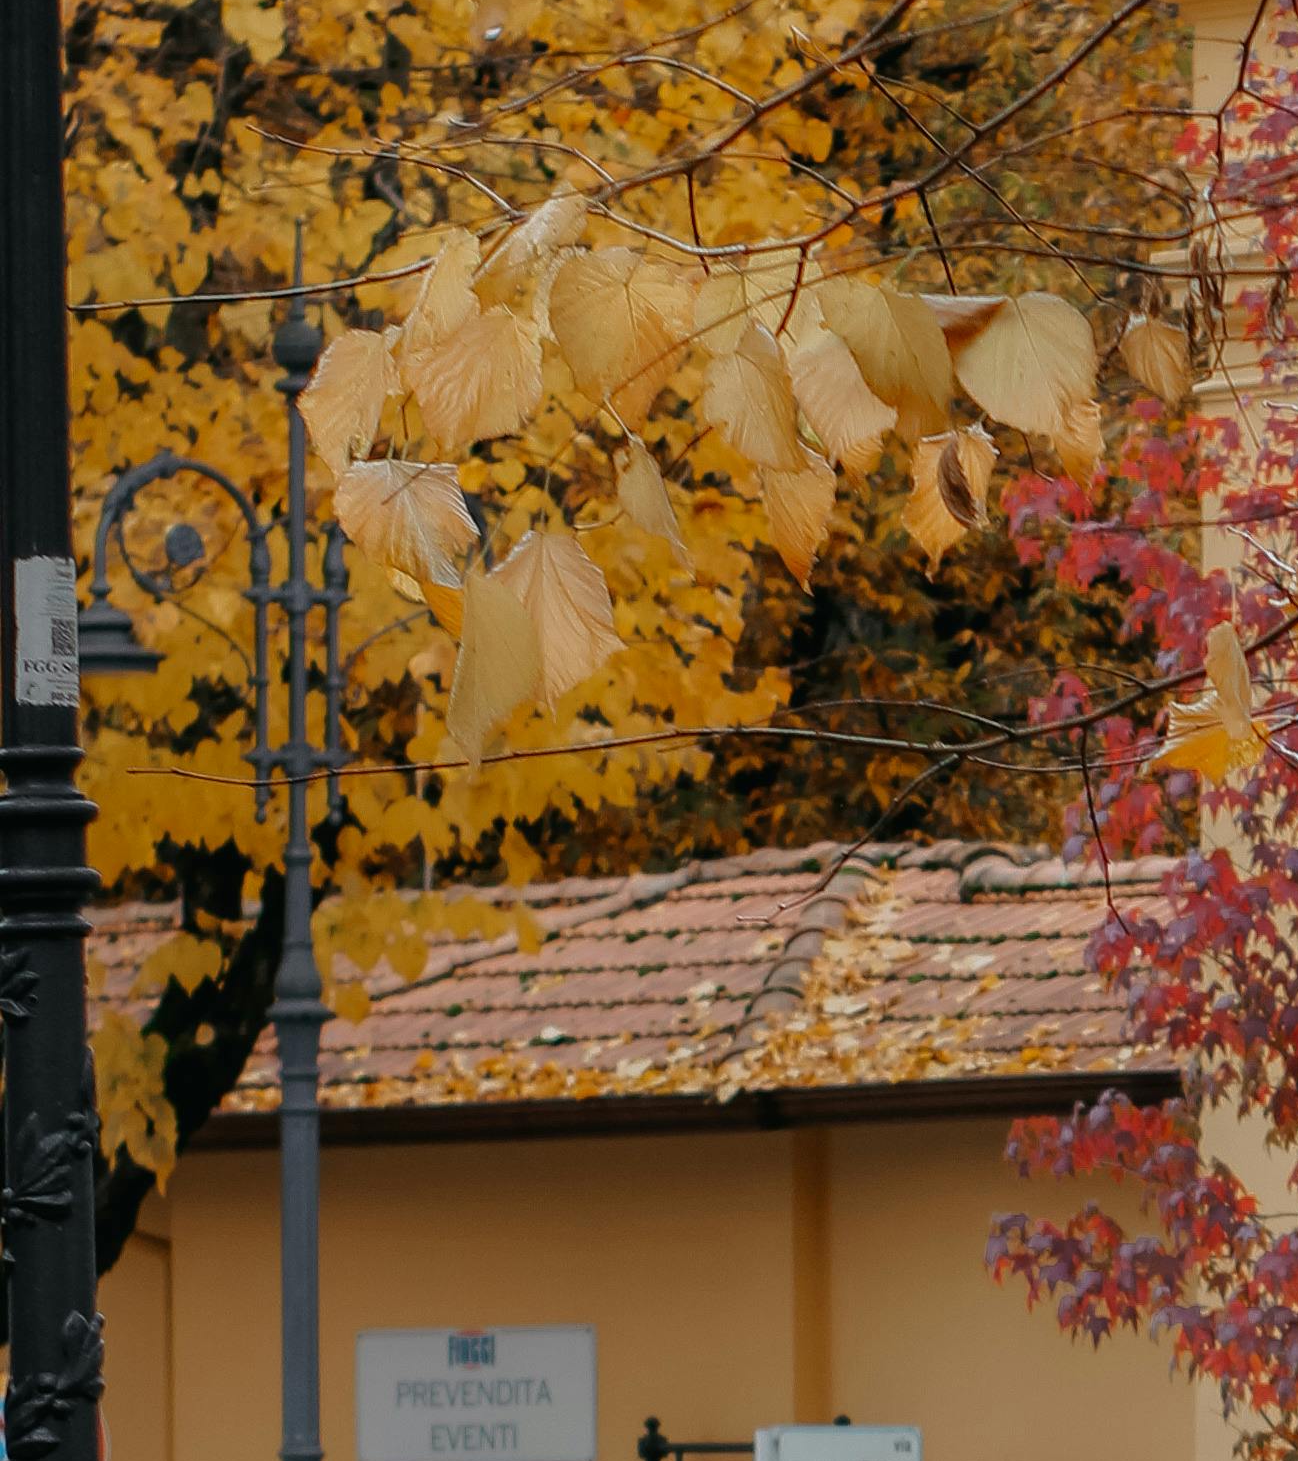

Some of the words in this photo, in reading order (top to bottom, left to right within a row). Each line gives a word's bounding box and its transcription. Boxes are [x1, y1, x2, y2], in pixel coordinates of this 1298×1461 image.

[396, 1379, 552, 1407] PREVENDITA
[431, 1424, 518, 1451] EVENTI
[894, 1439, 911, 1452] via
